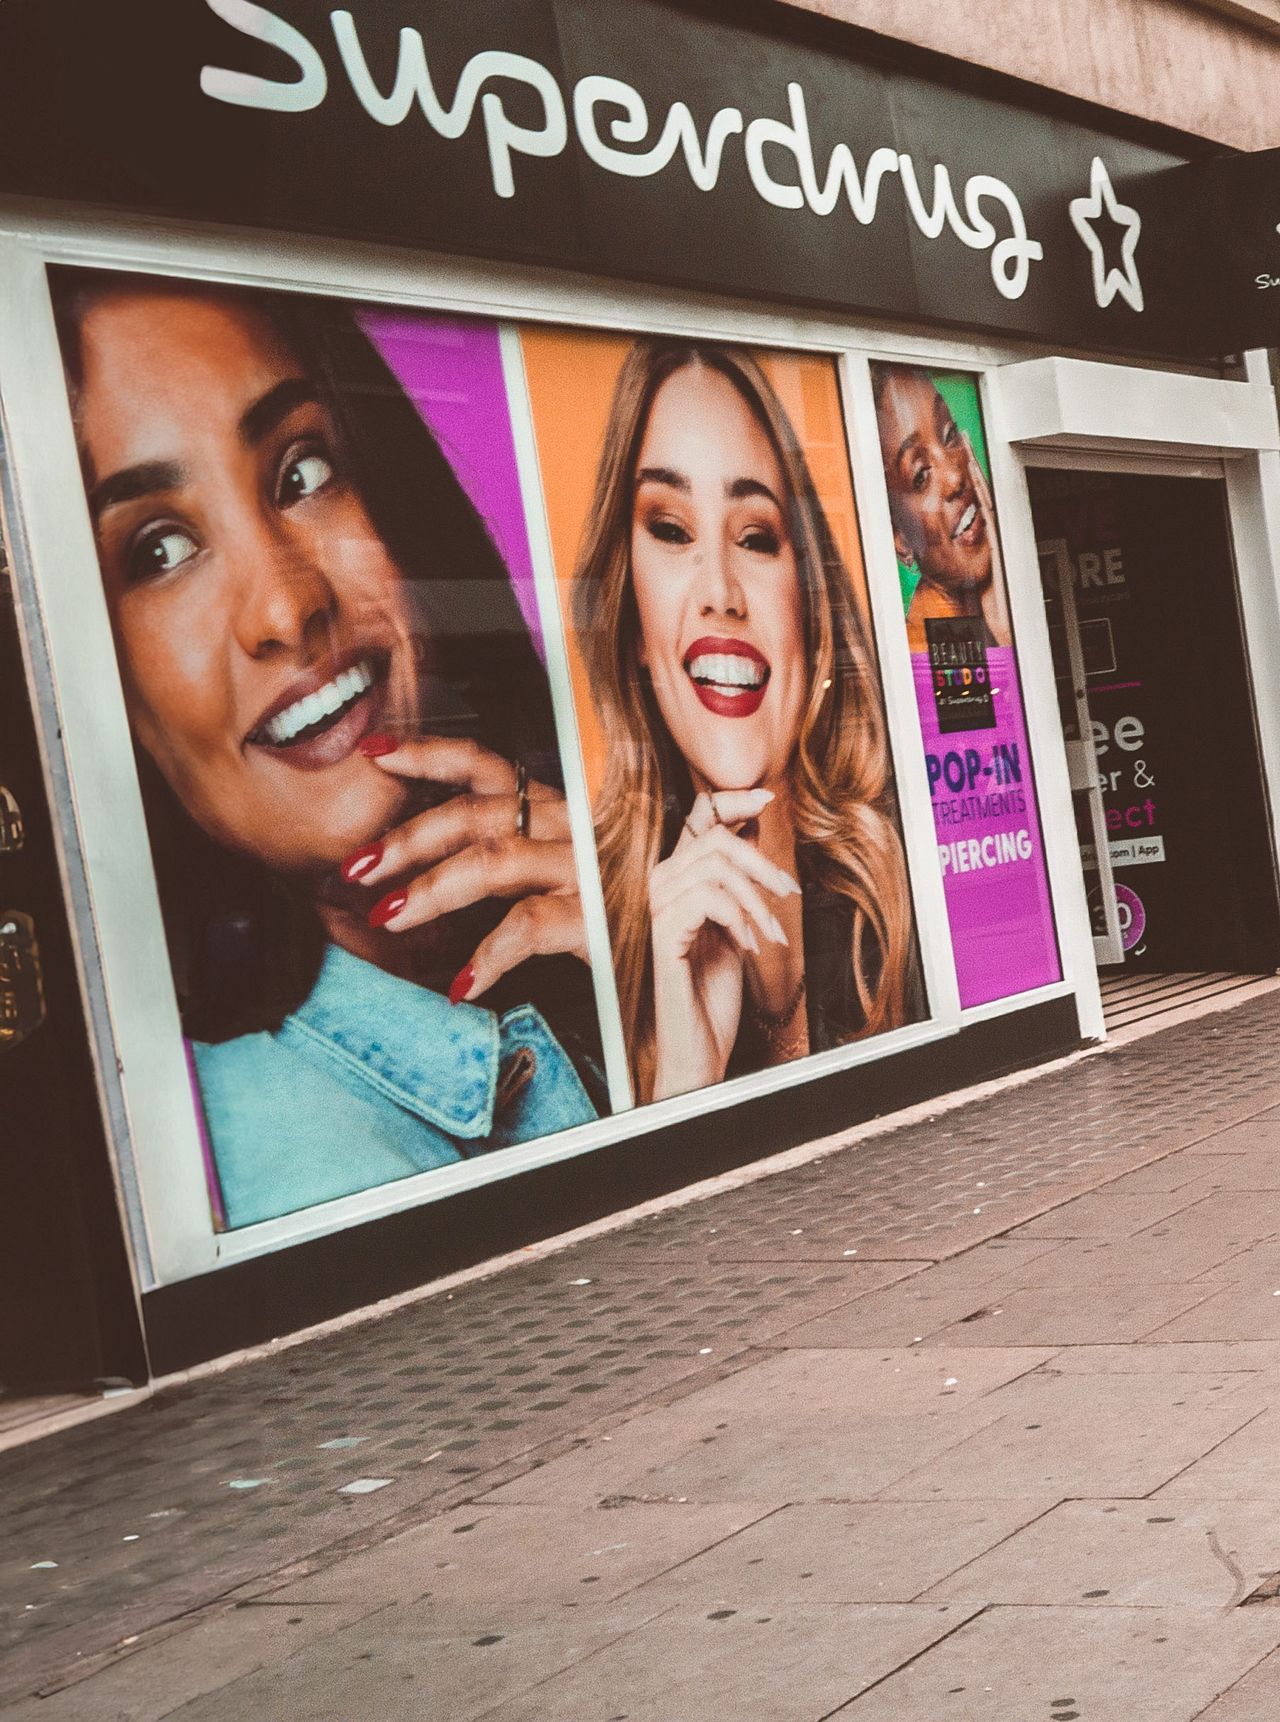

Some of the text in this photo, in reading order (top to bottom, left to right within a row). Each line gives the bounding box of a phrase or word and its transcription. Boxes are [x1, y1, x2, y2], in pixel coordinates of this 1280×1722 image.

[199, 0, 1044, 300] Superdrug
[935, 667, 986, 687] STUDO
[924, 742, 1022, 797] POP-IN
[1133, 760, 1156, 788] &
[932, 788, 1026, 825] TREATMENTS
[938, 828, 1033, 877] PIERCING
[1138, 845, 1160, 857] App
